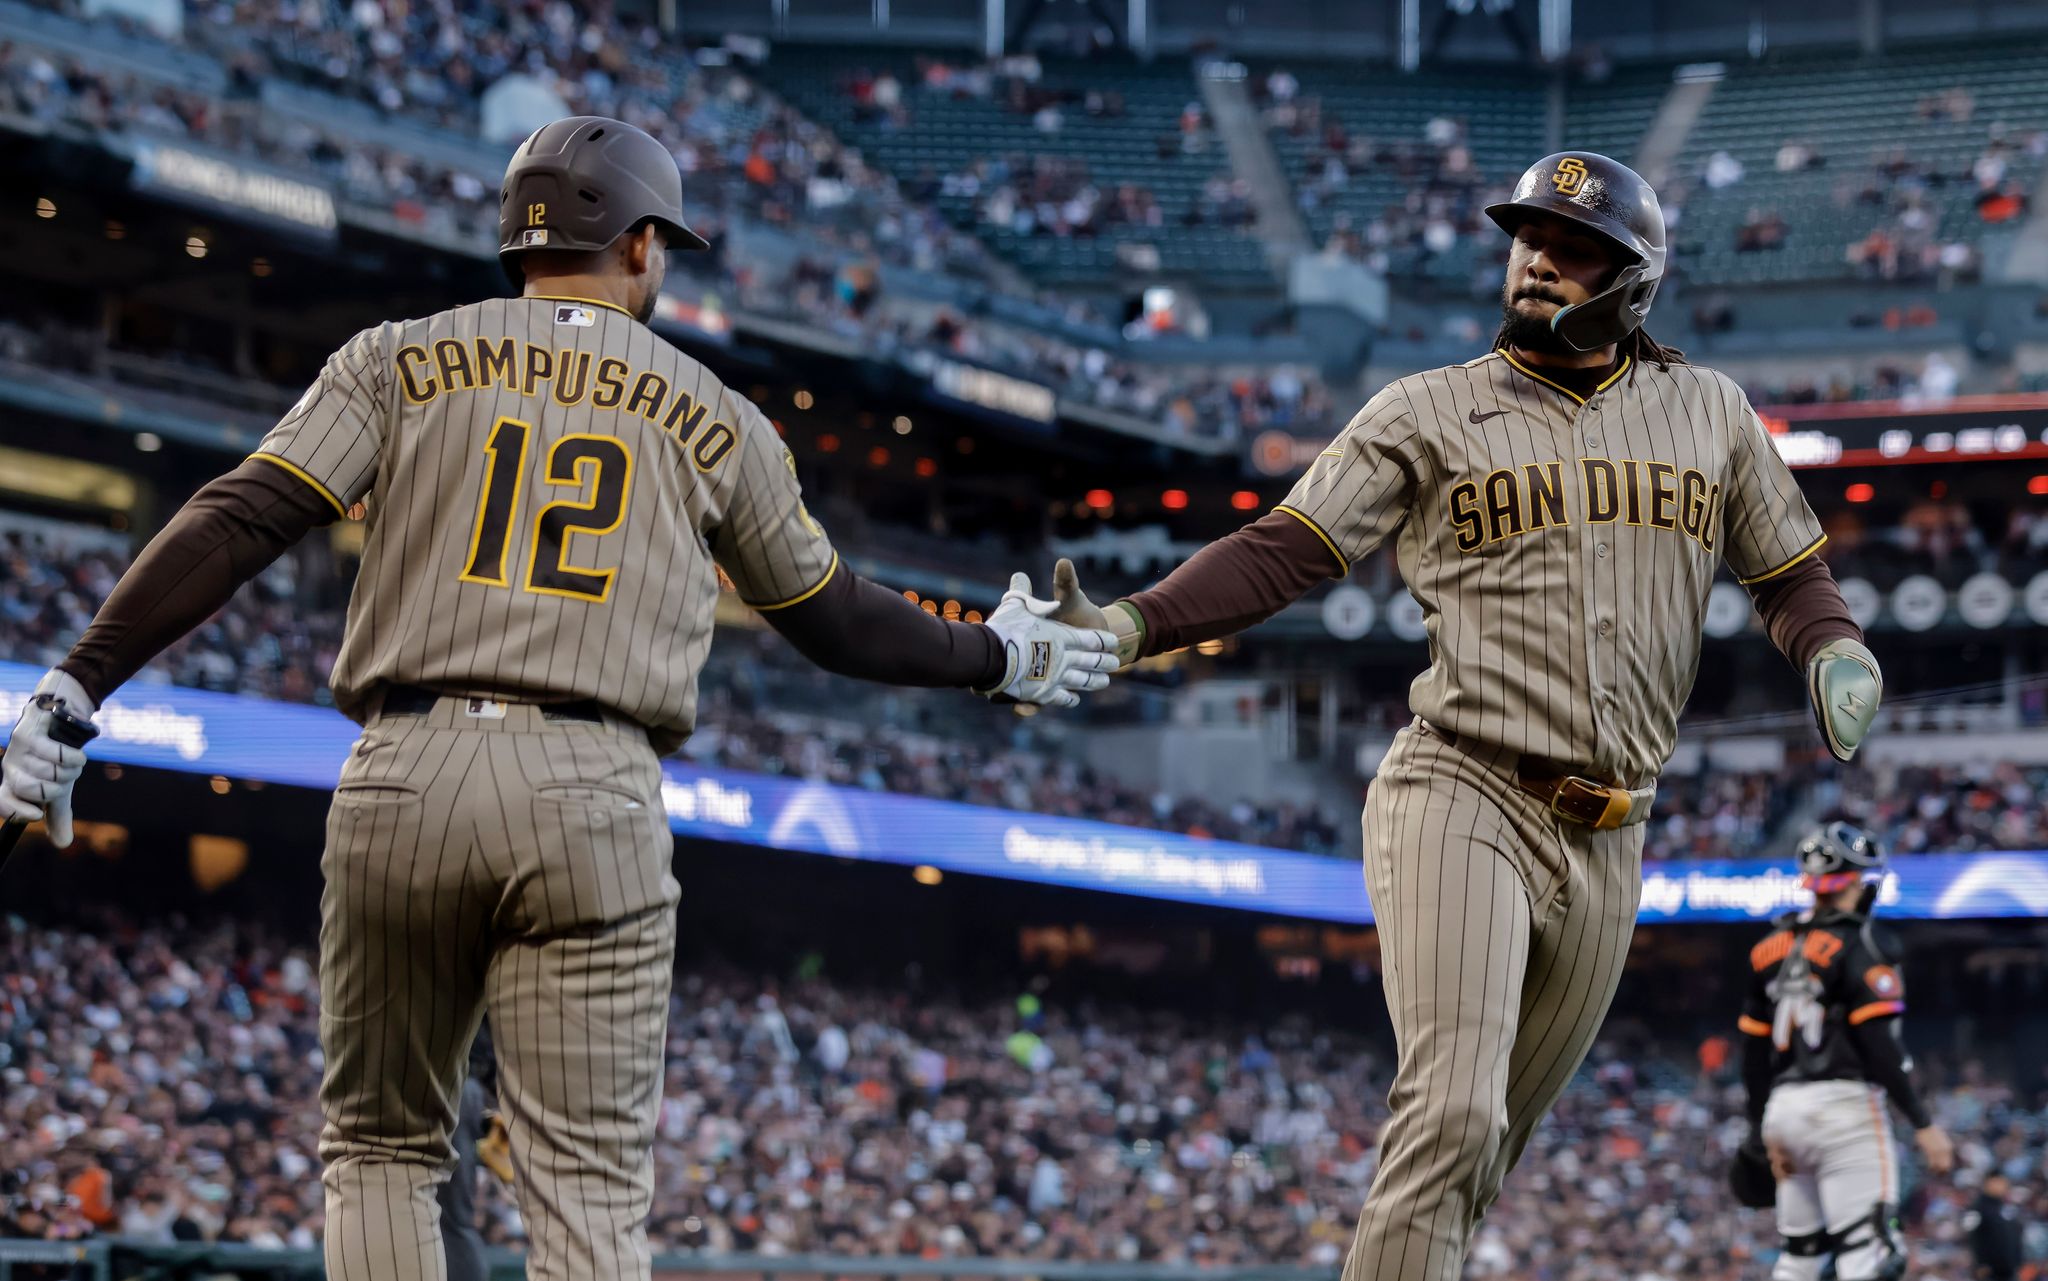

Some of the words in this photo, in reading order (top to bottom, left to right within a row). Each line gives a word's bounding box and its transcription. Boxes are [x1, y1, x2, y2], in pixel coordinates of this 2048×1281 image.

[528, 203, 546, 226] 12
[396, 336, 738, 474] CAMPUSANO
[457, 415, 633, 603] 12
[1449, 461, 1571, 553] SAN
[1578, 457, 1720, 553] DIEGO
